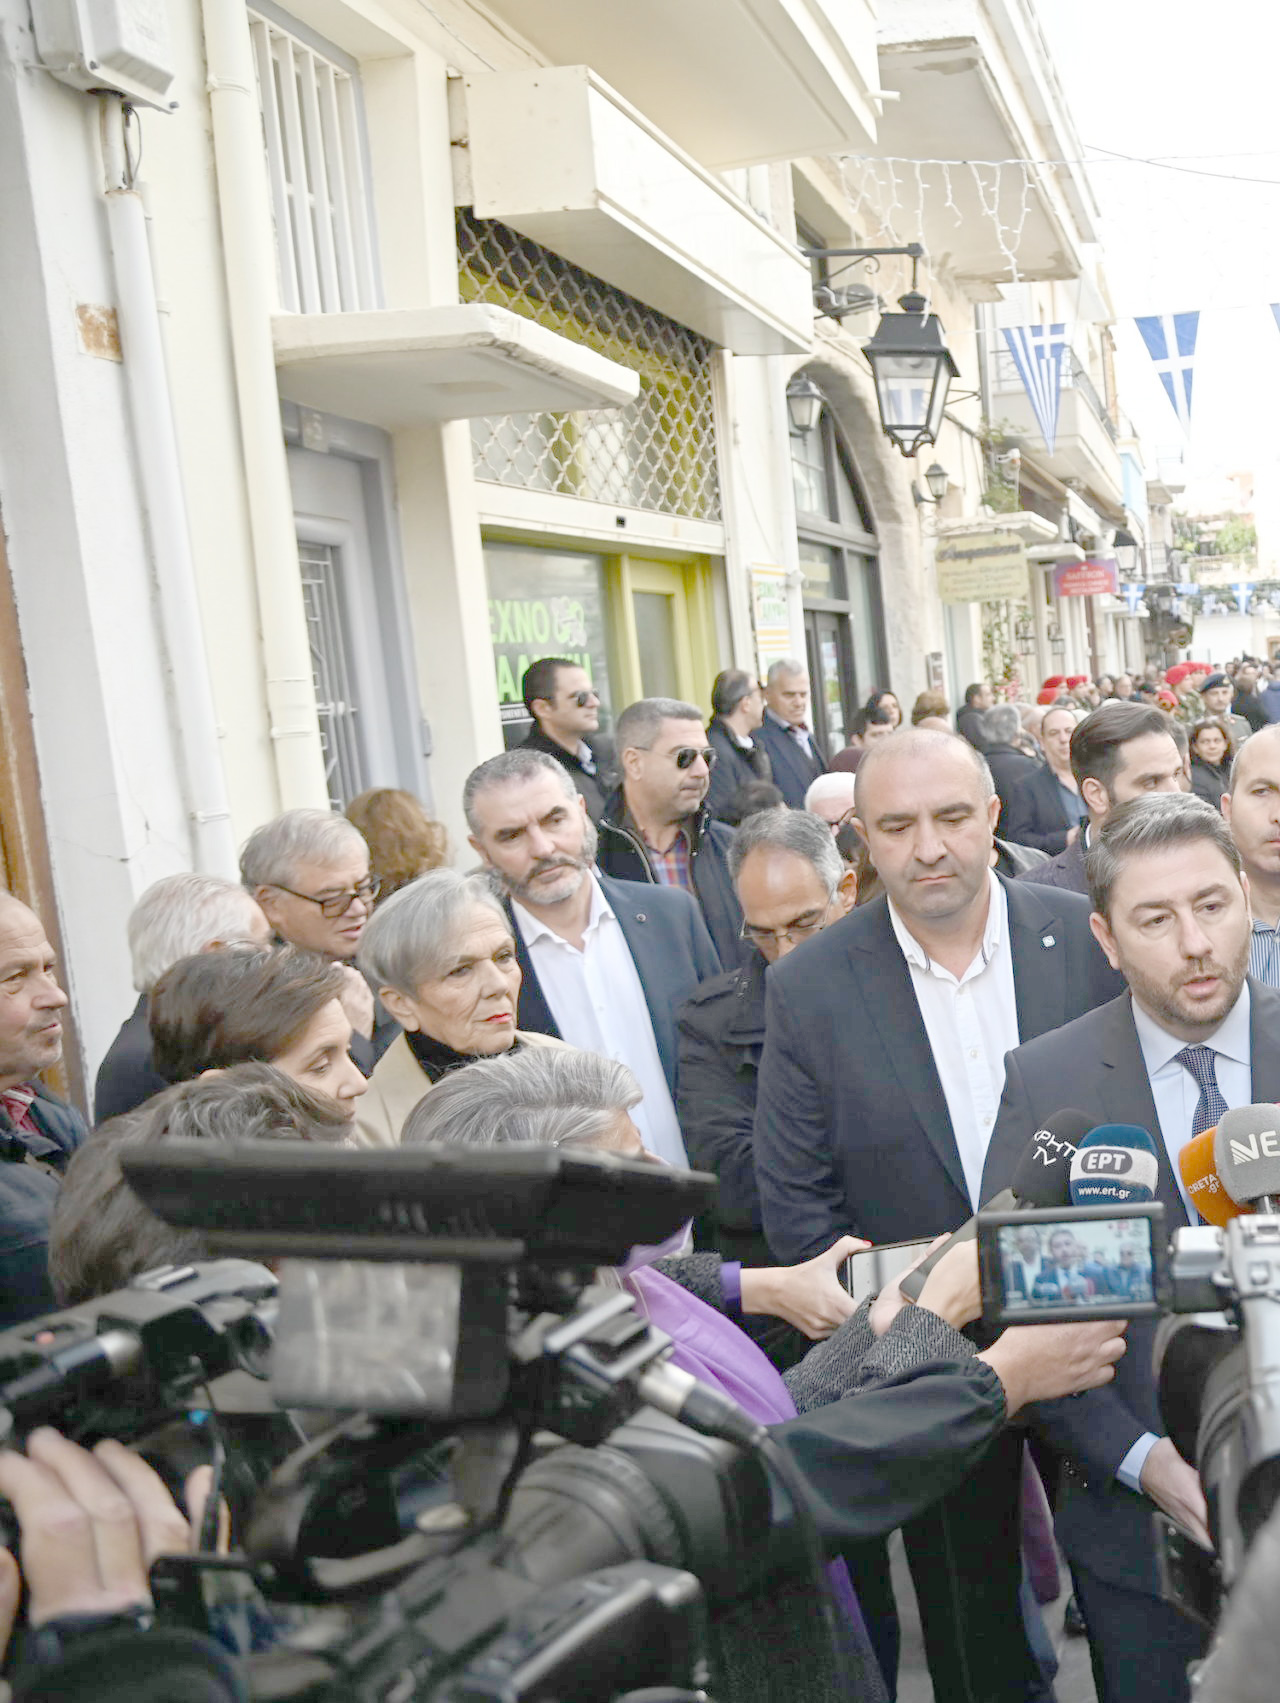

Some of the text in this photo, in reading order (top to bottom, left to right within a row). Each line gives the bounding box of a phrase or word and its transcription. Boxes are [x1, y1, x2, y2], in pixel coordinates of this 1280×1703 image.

[1032, 1145, 1057, 1166] TV
[1033, 1130, 1079, 1162] ΚΡΗΤ
[1087, 1152, 1126, 1171] ΕΡΤ
[1078, 1186, 1132, 1200] www.ert.gr
[1188, 1173, 1217, 1194] CRETA
